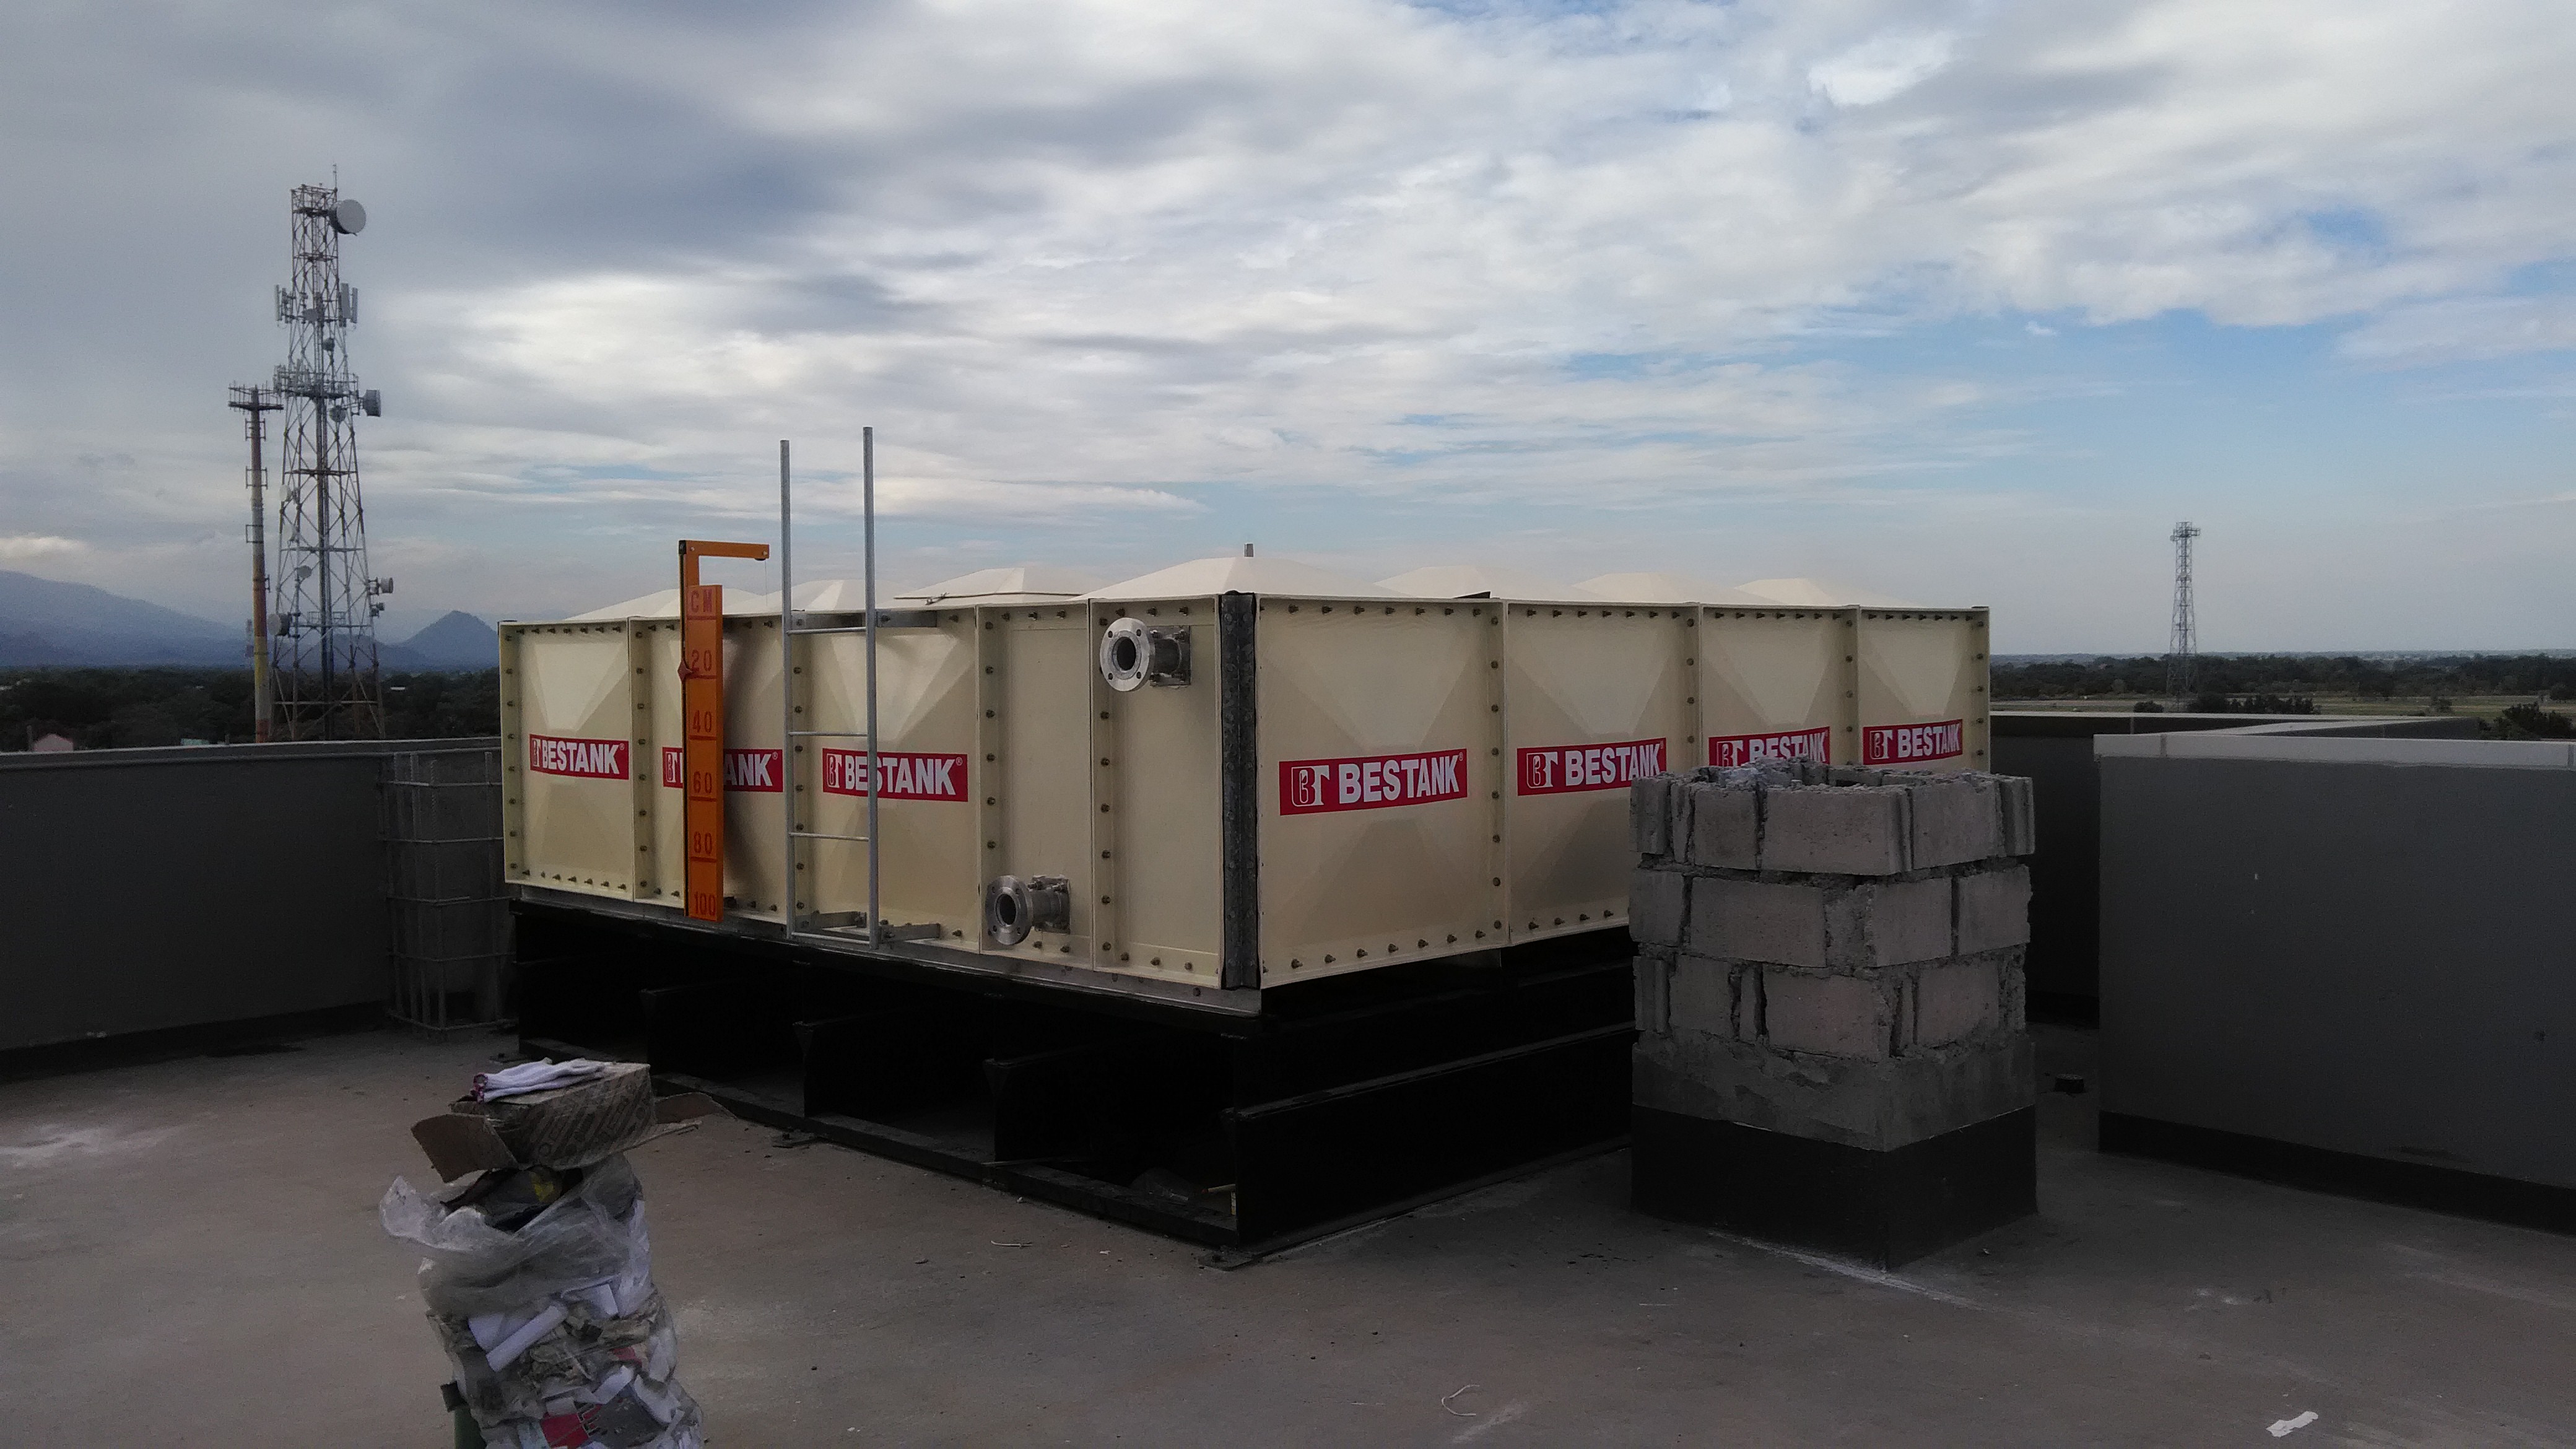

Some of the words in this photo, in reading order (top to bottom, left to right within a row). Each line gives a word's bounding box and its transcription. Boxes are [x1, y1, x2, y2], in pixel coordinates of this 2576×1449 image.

[691, 590, 712, 612] CM
[692, 650, 712, 672] 20
[693, 710, 712, 733] 40
[1897, 723, 1960, 758] BESTANK
[542, 740, 620, 774] BESTANK
[1565, 744, 1661, 786] BESTANK
[694, 771, 712, 793] 60
[1338, 755, 1460, 804] BESTANK
[694, 832, 712, 855] 80
[695, 892, 716, 915] 100
